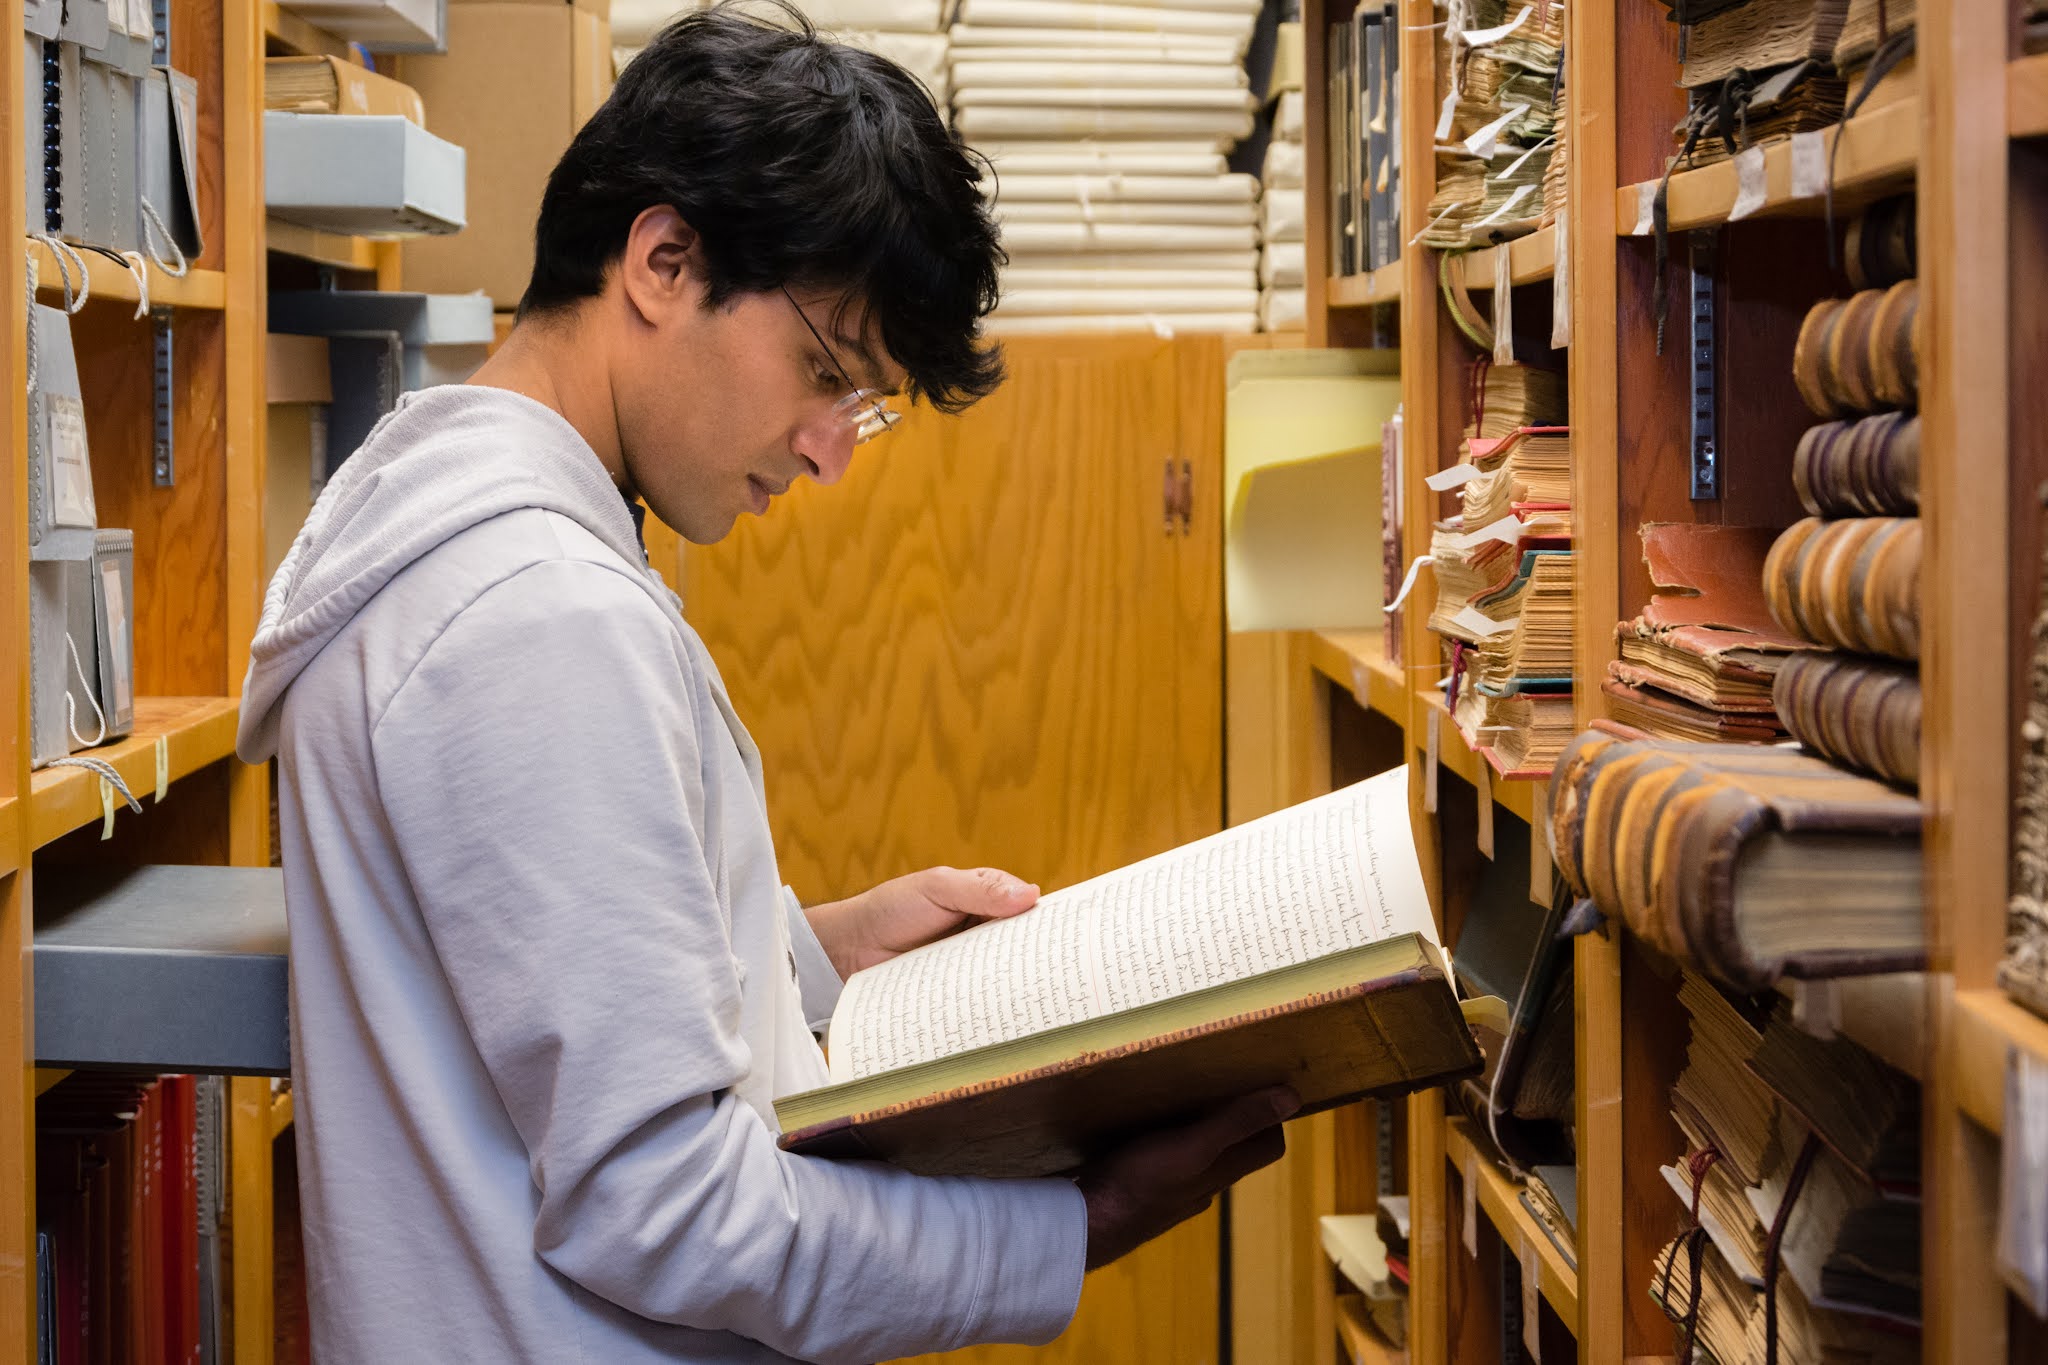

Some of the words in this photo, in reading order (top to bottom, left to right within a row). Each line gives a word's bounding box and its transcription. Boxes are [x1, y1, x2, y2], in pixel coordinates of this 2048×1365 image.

[1261, 891, 1273, 912] and
[1290, 891, 1300, 902] to
[1315, 871, 1339, 948] consecutively
[1329, 881, 1343, 893] of
[1336, 893, 1347, 916] like
[1192, 909, 1204, 935] duly
[1223, 914, 1235, 935] and
[1278, 905, 1289, 926] the
[1292, 903, 1303, 928] One
[1350, 907, 1365, 920] of
[1113, 929, 1124, 950] this
[1181, 918, 1191, 936] the
[1236, 908, 1253, 953] executed
[1141, 938, 1154, 961] and
[1169, 935, 1183, 962] said
[1211, 928, 1229, 979] Security
[1256, 934, 1270, 960] deed
[1071, 945, 1088, 989] payment
[1101, 951, 1113, 972] and
[1114, 949, 1128, 977] bond
[1123, 950, 1143, 978] forth
[1146, 960, 1158, 980] all
[1182, 937, 1202, 987] corporate
[1020, 990, 1034, 1001] of
[1063, 978, 1077, 1010] made
[1120, 977, 1127, 990] is
[1149, 980, 1162, 999] its
[1162, 969, 1172, 996] now
[968, 977, 984, 1042] immediately
[1033, 986, 1052, 1028] default
[1049, 975, 1067, 1021] interest
[1075, 991, 1091, 1003] of
[929, 1006, 940, 1028] that
[939, 1009, 952, 1040] agreed
[979, 989, 996, 1035] principal
[1024, 1001, 1034, 1027] any
[931, 1028, 938, 1044] no
[952, 1004, 968, 1052] mortgage
[942, 1040, 954, 1056] by
